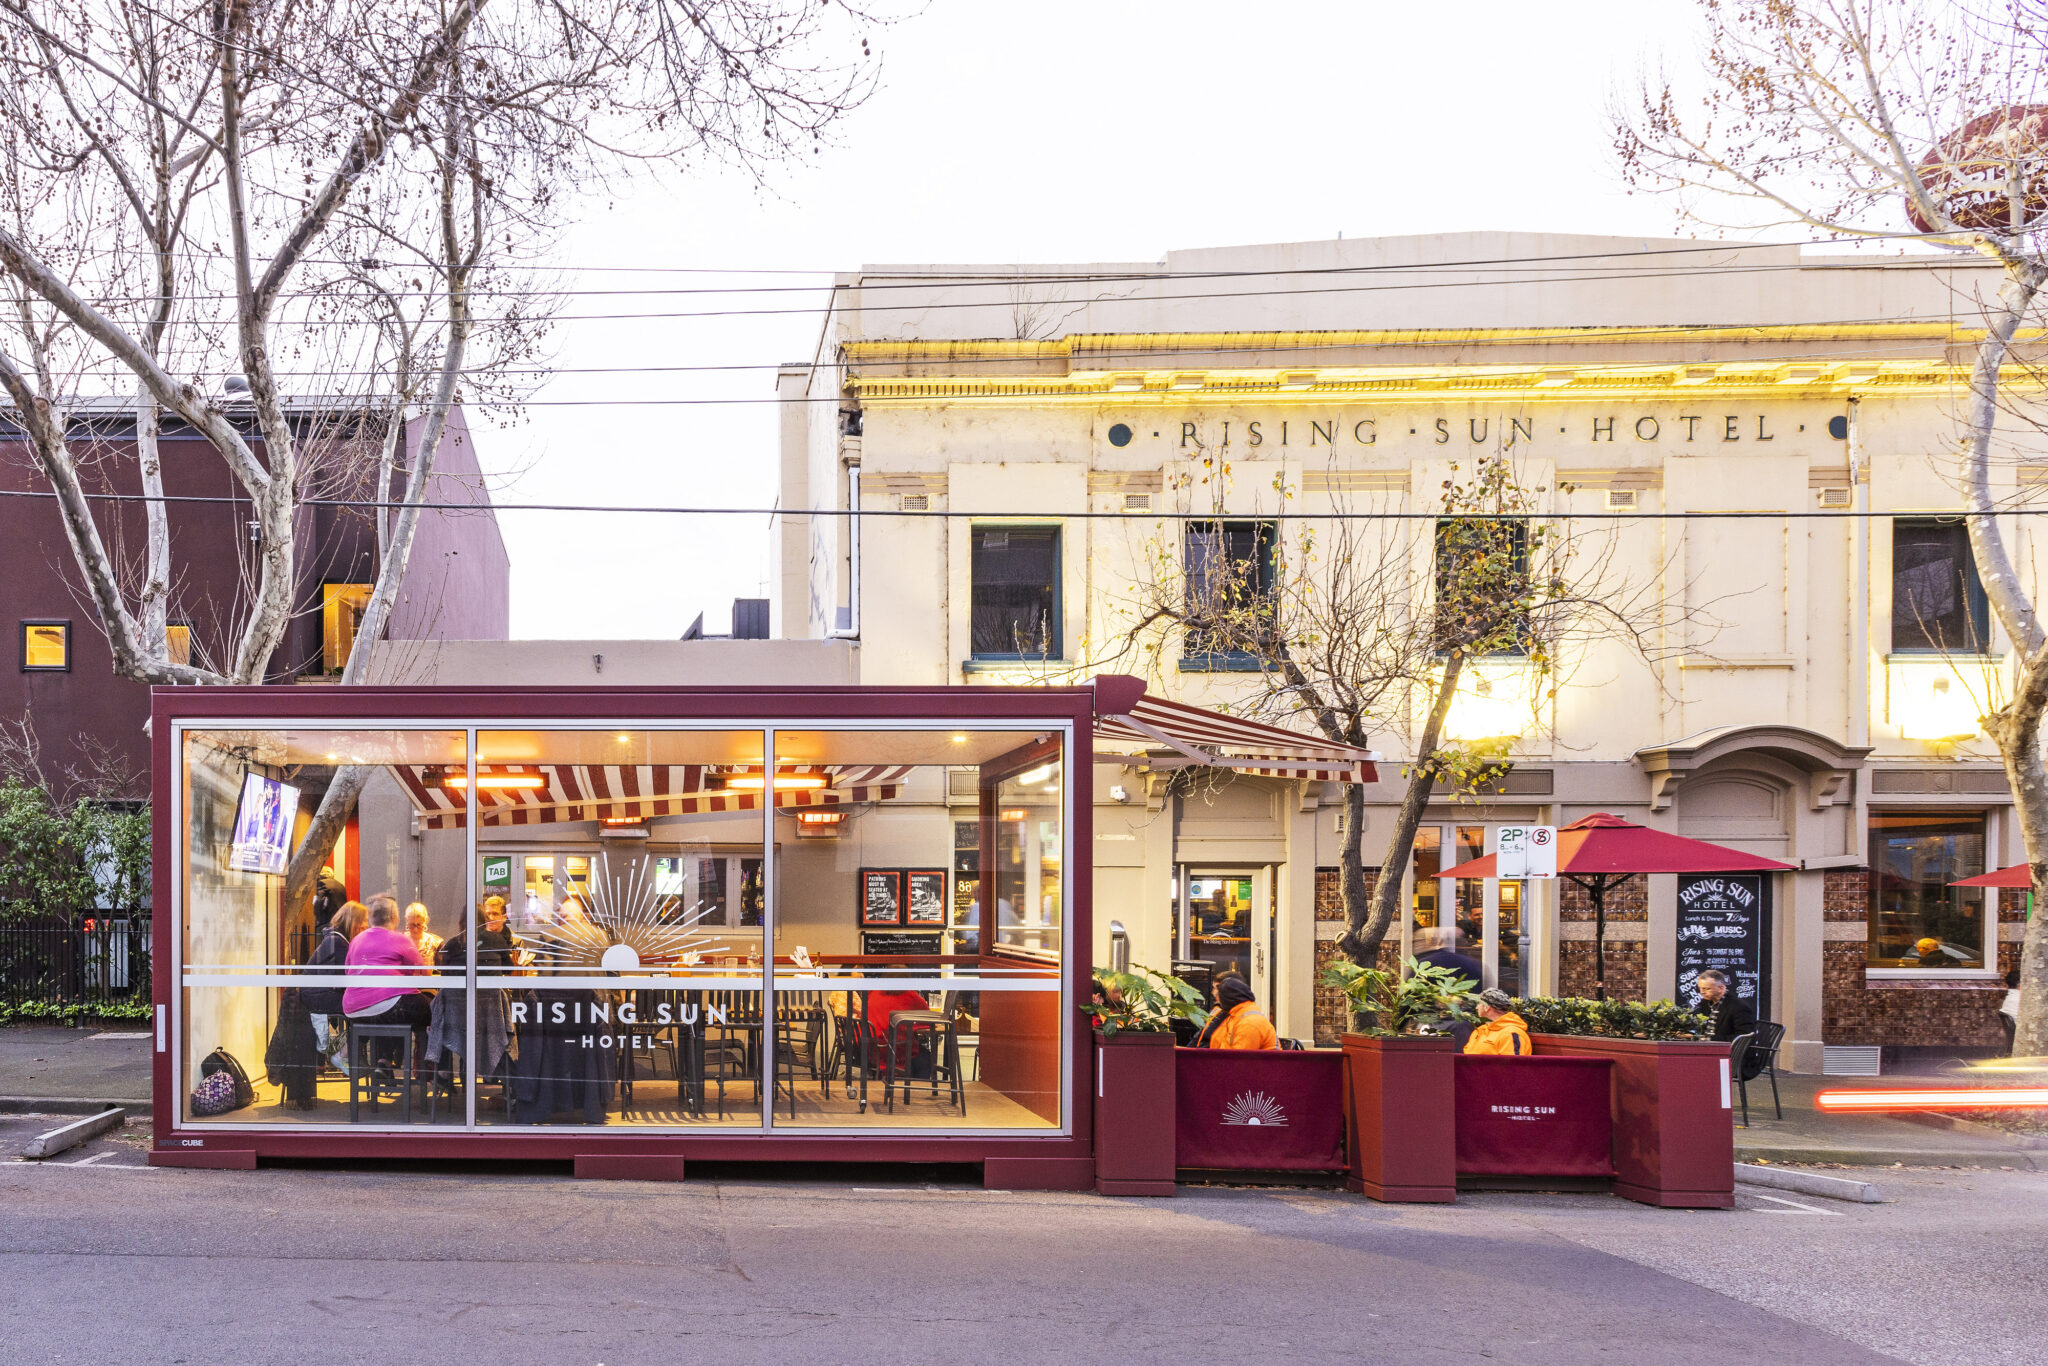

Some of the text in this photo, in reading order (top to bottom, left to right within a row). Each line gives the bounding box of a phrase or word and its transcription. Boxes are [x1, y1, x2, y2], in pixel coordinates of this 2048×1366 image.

[1180, 415, 1776, 447] RISING SUN HOTEL
[1501, 829, 1523, 841] 2P
[488, 867, 506, 876] TAB
[1679, 878, 1755, 907] RISING SUN
[1726, 913, 1734, 921] 7
[1683, 925, 1743, 937] LIVE MUSIC
[511, 1002, 727, 1025] RISING SUN
[582, 1035, 656, 1049] HOTEL
[1491, 1105, 1556, 1114] RISING SUN
